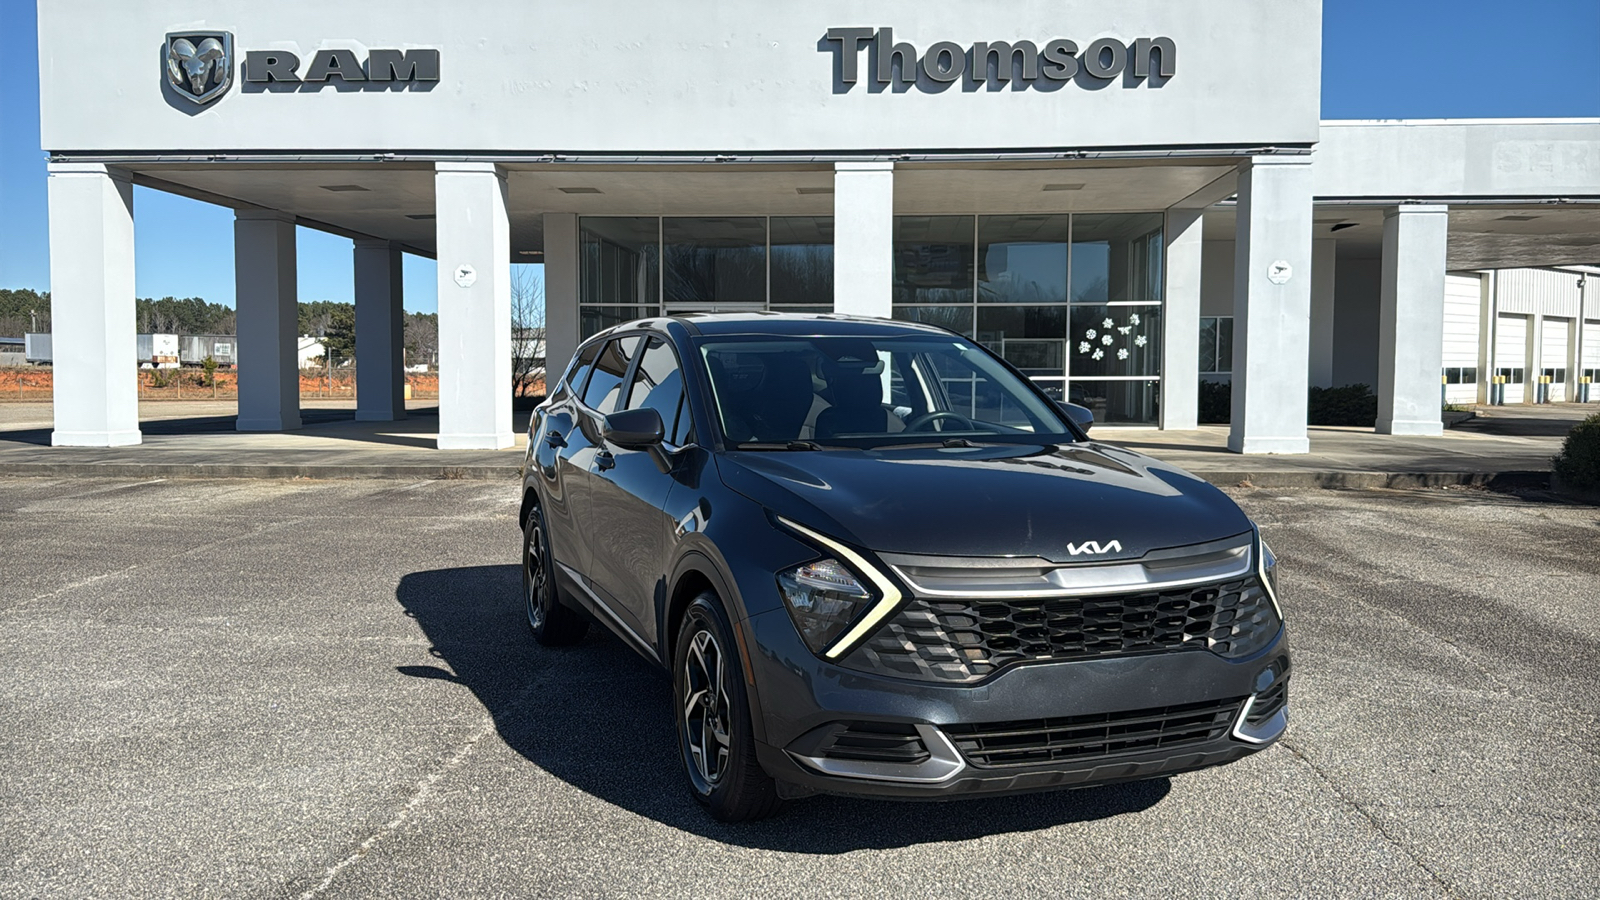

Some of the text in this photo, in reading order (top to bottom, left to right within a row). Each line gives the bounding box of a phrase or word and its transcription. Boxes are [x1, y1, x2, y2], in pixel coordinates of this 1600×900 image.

[246, 49, 440, 82] RAM
[826, 27, 1176, 82] Thomson
[1066, 539, 1122, 556] KIA
